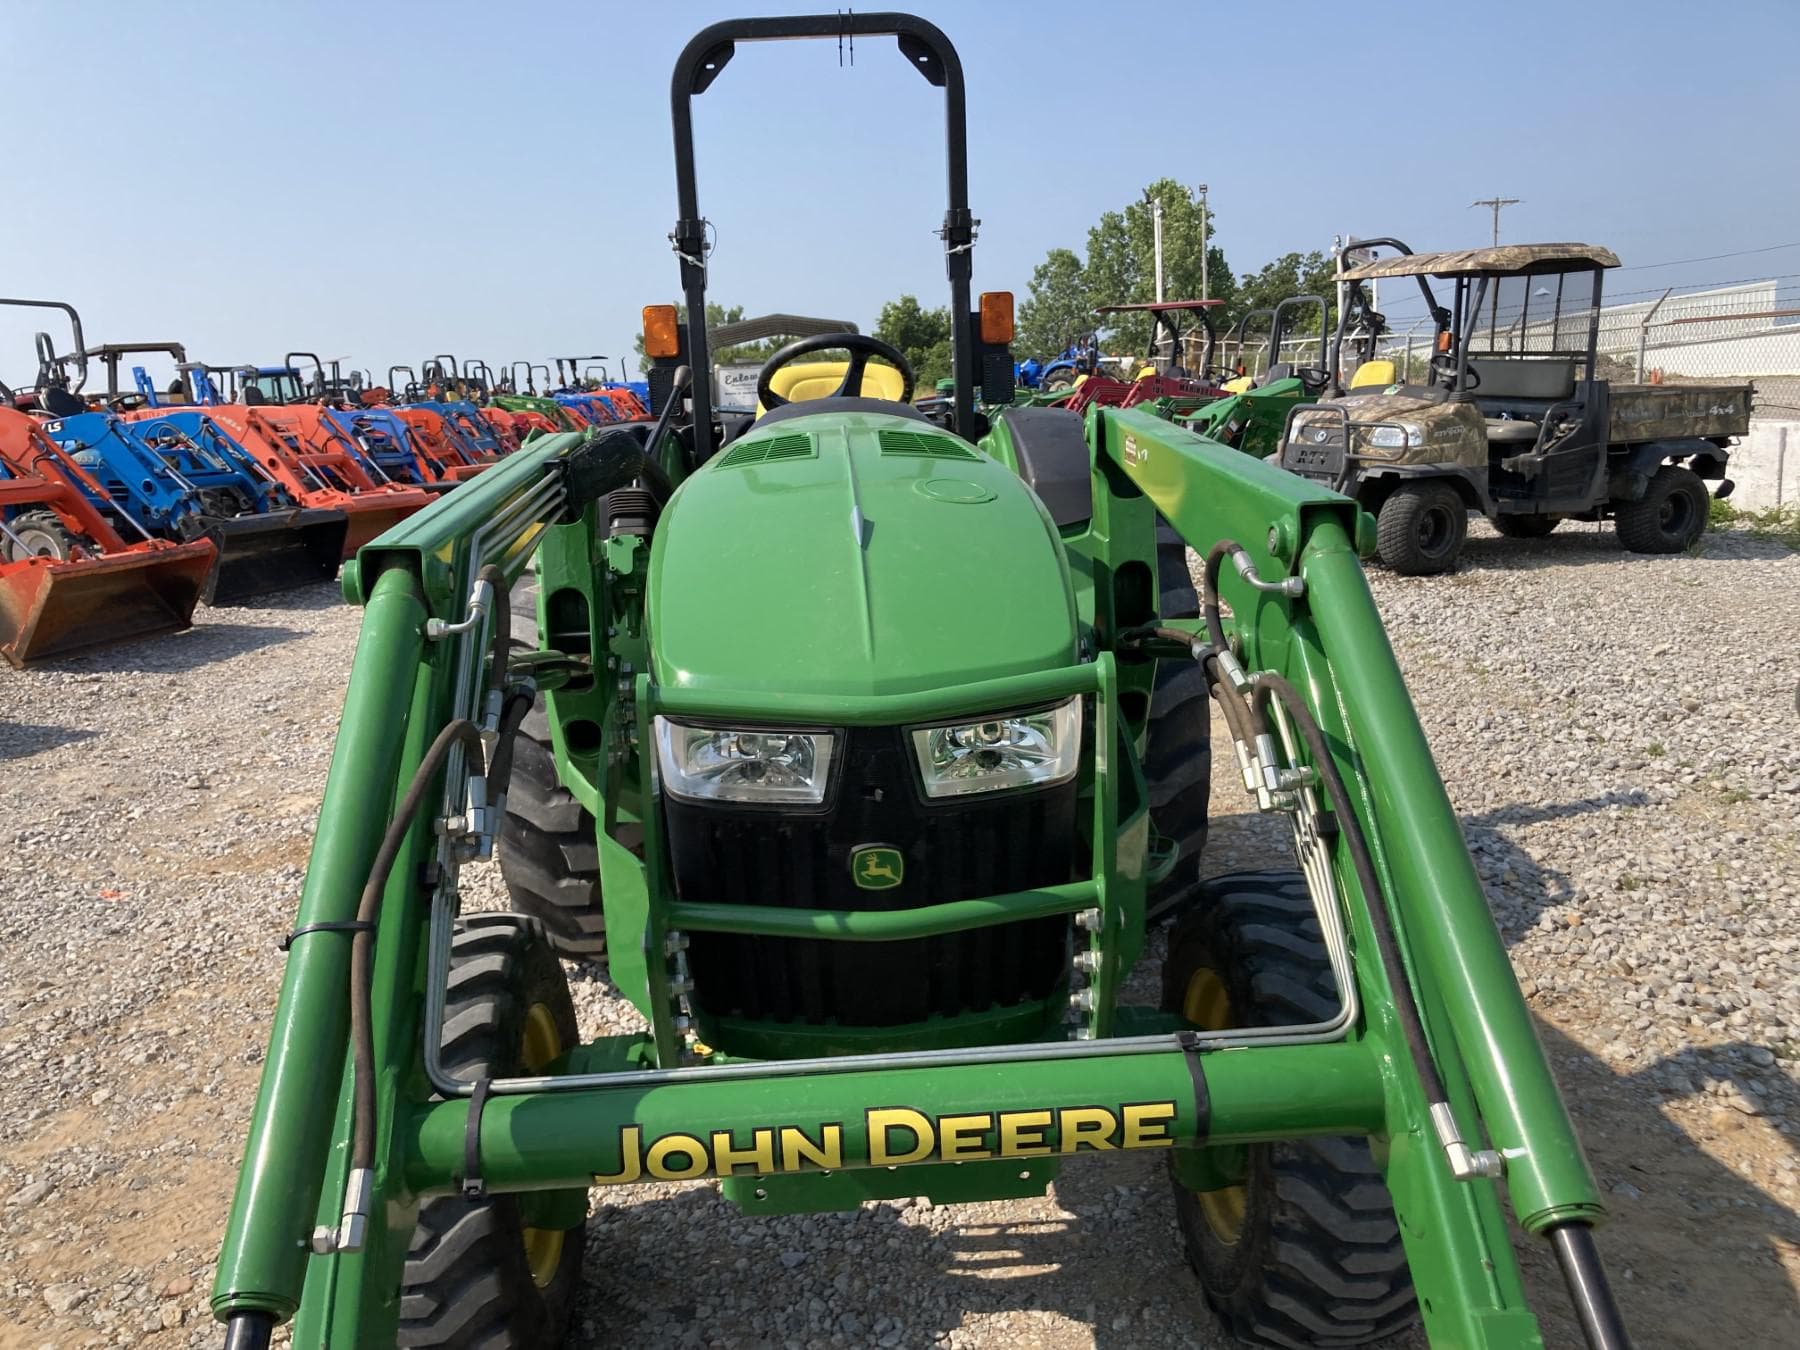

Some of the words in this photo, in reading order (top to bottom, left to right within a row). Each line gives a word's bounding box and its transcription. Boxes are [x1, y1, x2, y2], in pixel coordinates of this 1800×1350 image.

[1709, 405, 1735, 416] 4x4
[47, 422, 62, 433] LS
[1296, 450, 1329, 465] RTV
[592, 1122, 845, 1185] JOHN
[864, 1100, 1178, 1166] DEERE
